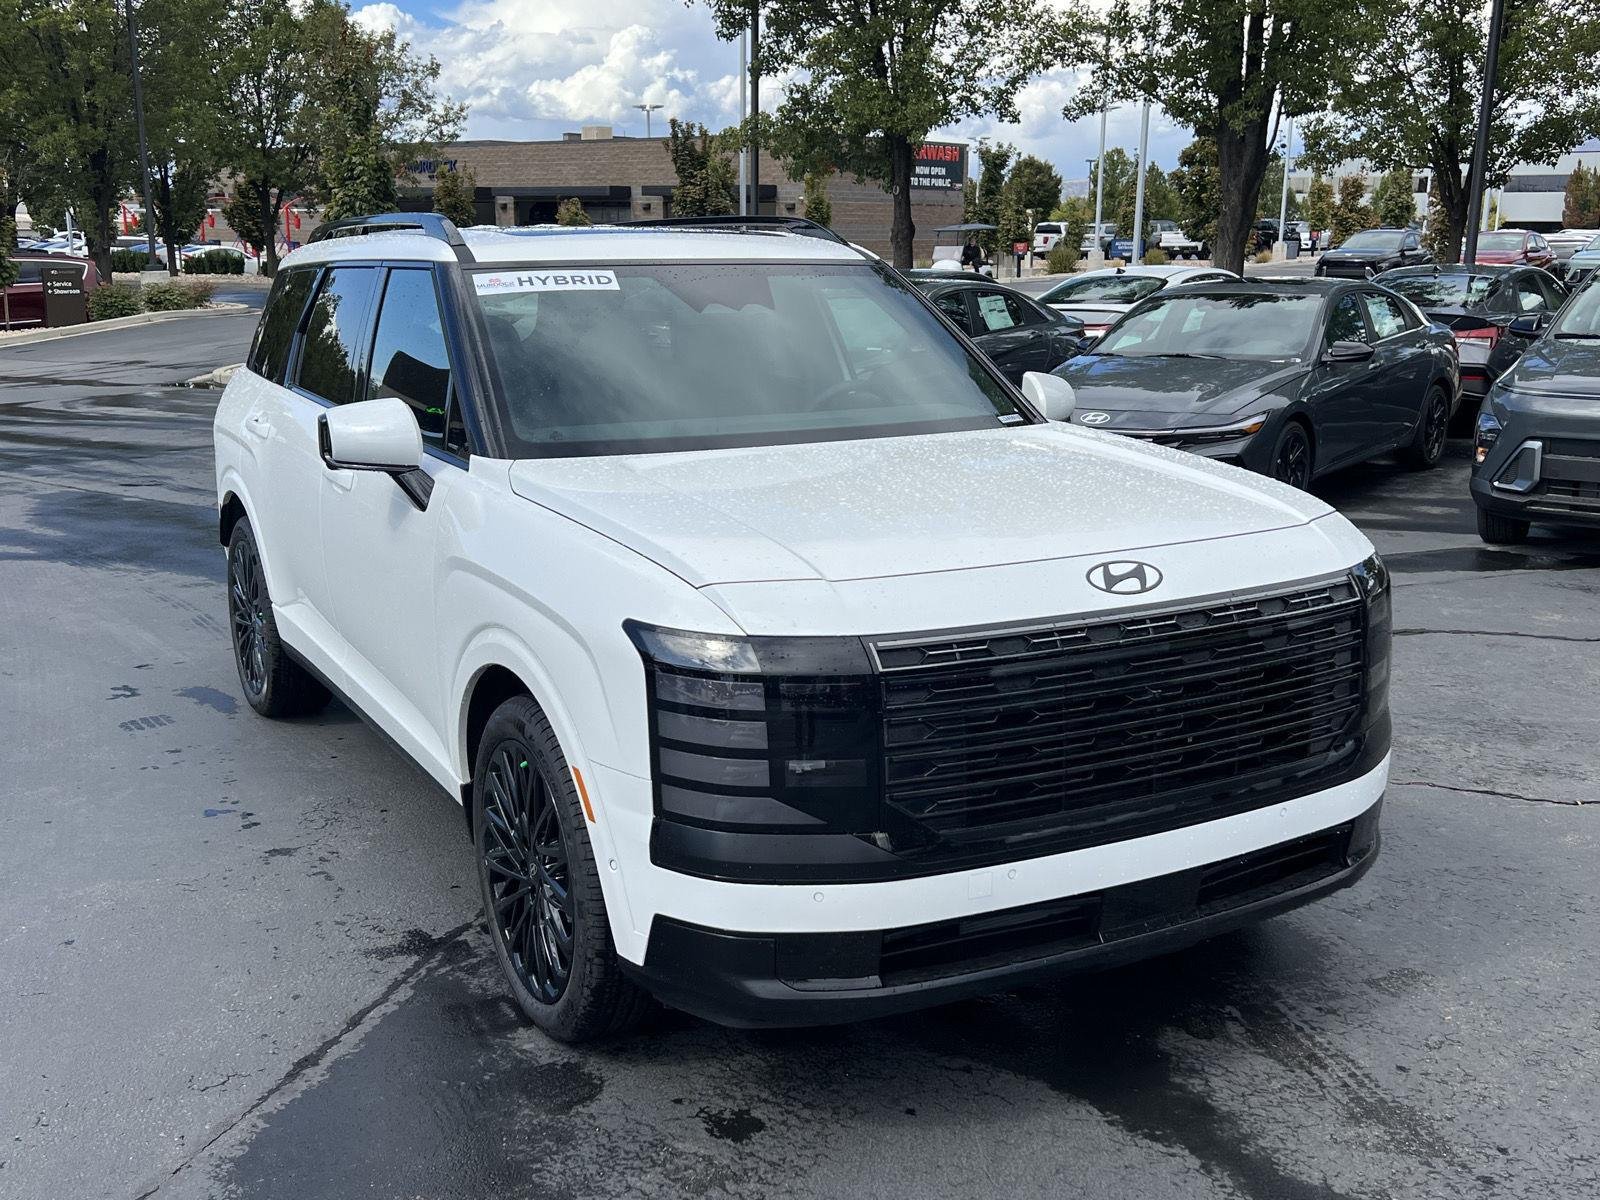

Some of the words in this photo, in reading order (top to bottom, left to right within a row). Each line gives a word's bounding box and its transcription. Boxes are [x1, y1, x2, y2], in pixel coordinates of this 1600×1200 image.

[915, 166, 930, 175] NOW
[931, 166, 946, 175] OPEN
[910, 177, 919, 186] TO
[919, 178, 931, 186] THE
[931, 178, 951, 187] PUBLIC
[517, 275, 613, 287] HYBRID
